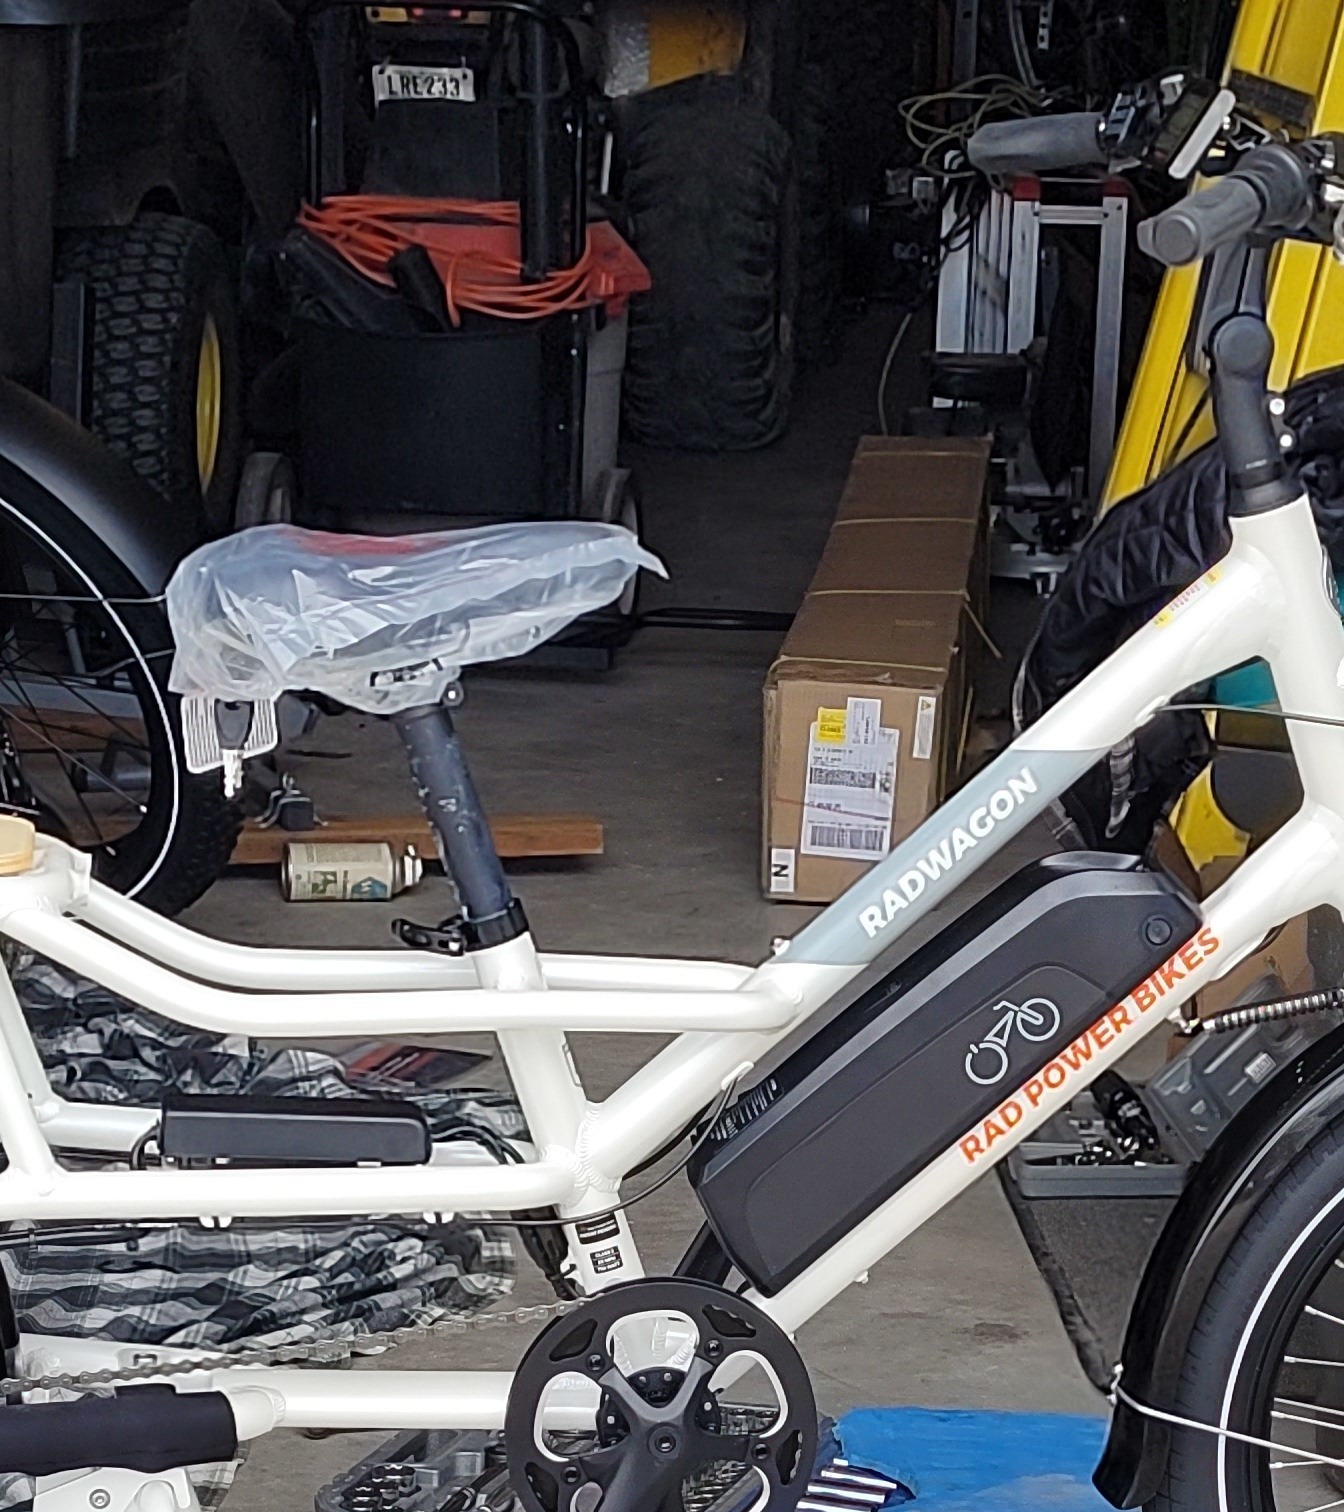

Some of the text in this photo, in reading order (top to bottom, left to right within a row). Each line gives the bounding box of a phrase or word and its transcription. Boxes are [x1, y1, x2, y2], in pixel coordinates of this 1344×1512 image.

[859, 766, 1038, 938] RADWAGON
[959, 927, 1222, 1163] RAD POWER BIKES
